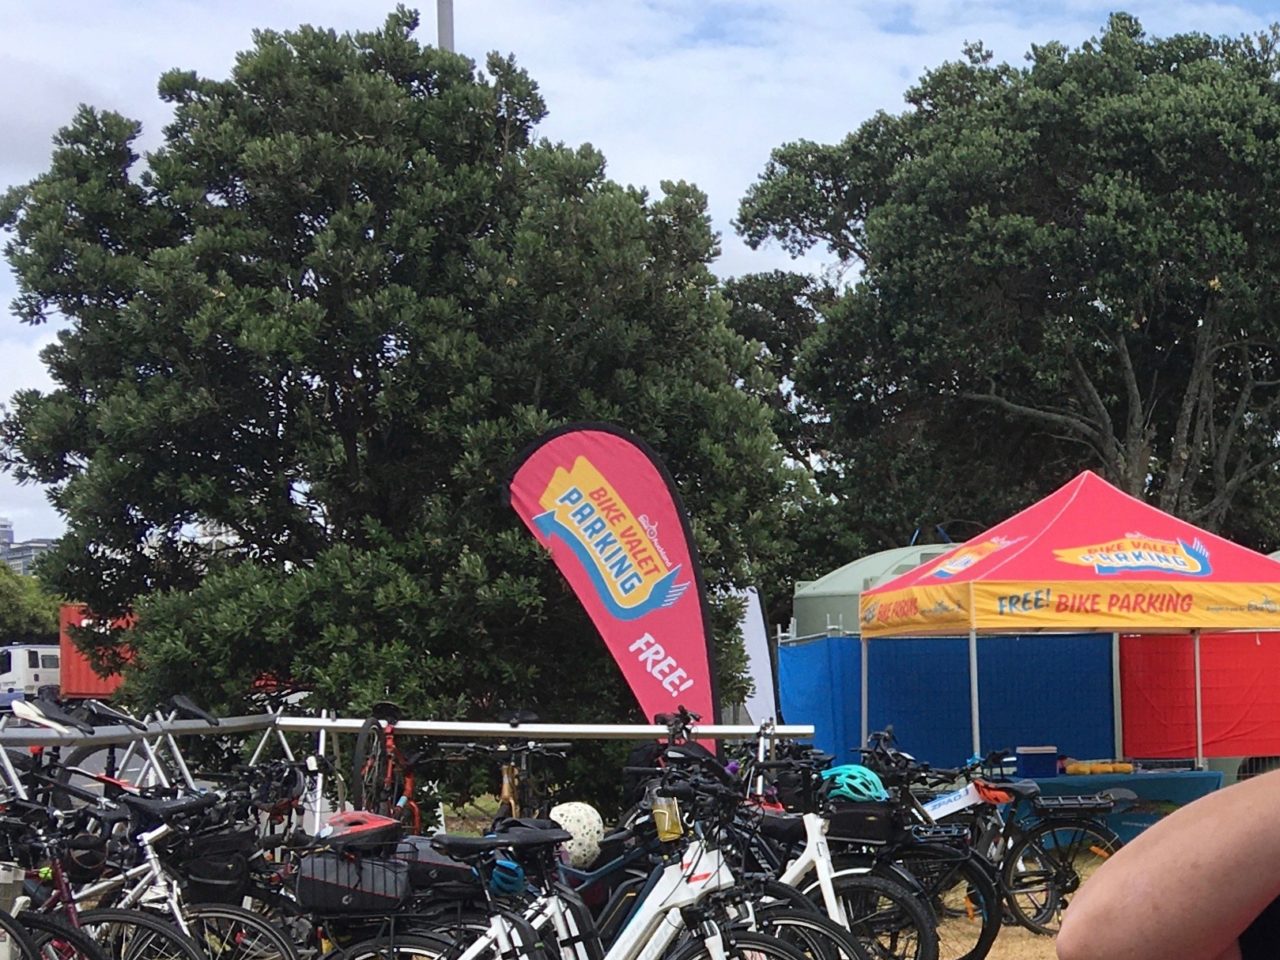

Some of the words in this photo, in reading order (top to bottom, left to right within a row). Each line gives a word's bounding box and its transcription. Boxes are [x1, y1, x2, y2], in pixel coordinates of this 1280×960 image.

[557, 484, 644, 597] PARKING
[588, 486, 626, 527] BIKE
[619, 525, 662, 577] VALET
[1087, 543, 1126, 555] BIKE
[1131, 540, 1179, 555] VALET
[1080, 550, 1188, 567] PARKING
[998, 588, 1051, 616] FREE!
[1055, 593, 1102, 614] BIKE
[1107, 592, 1194, 614] PARKING
[628, 632, 694, 698] FREE!
